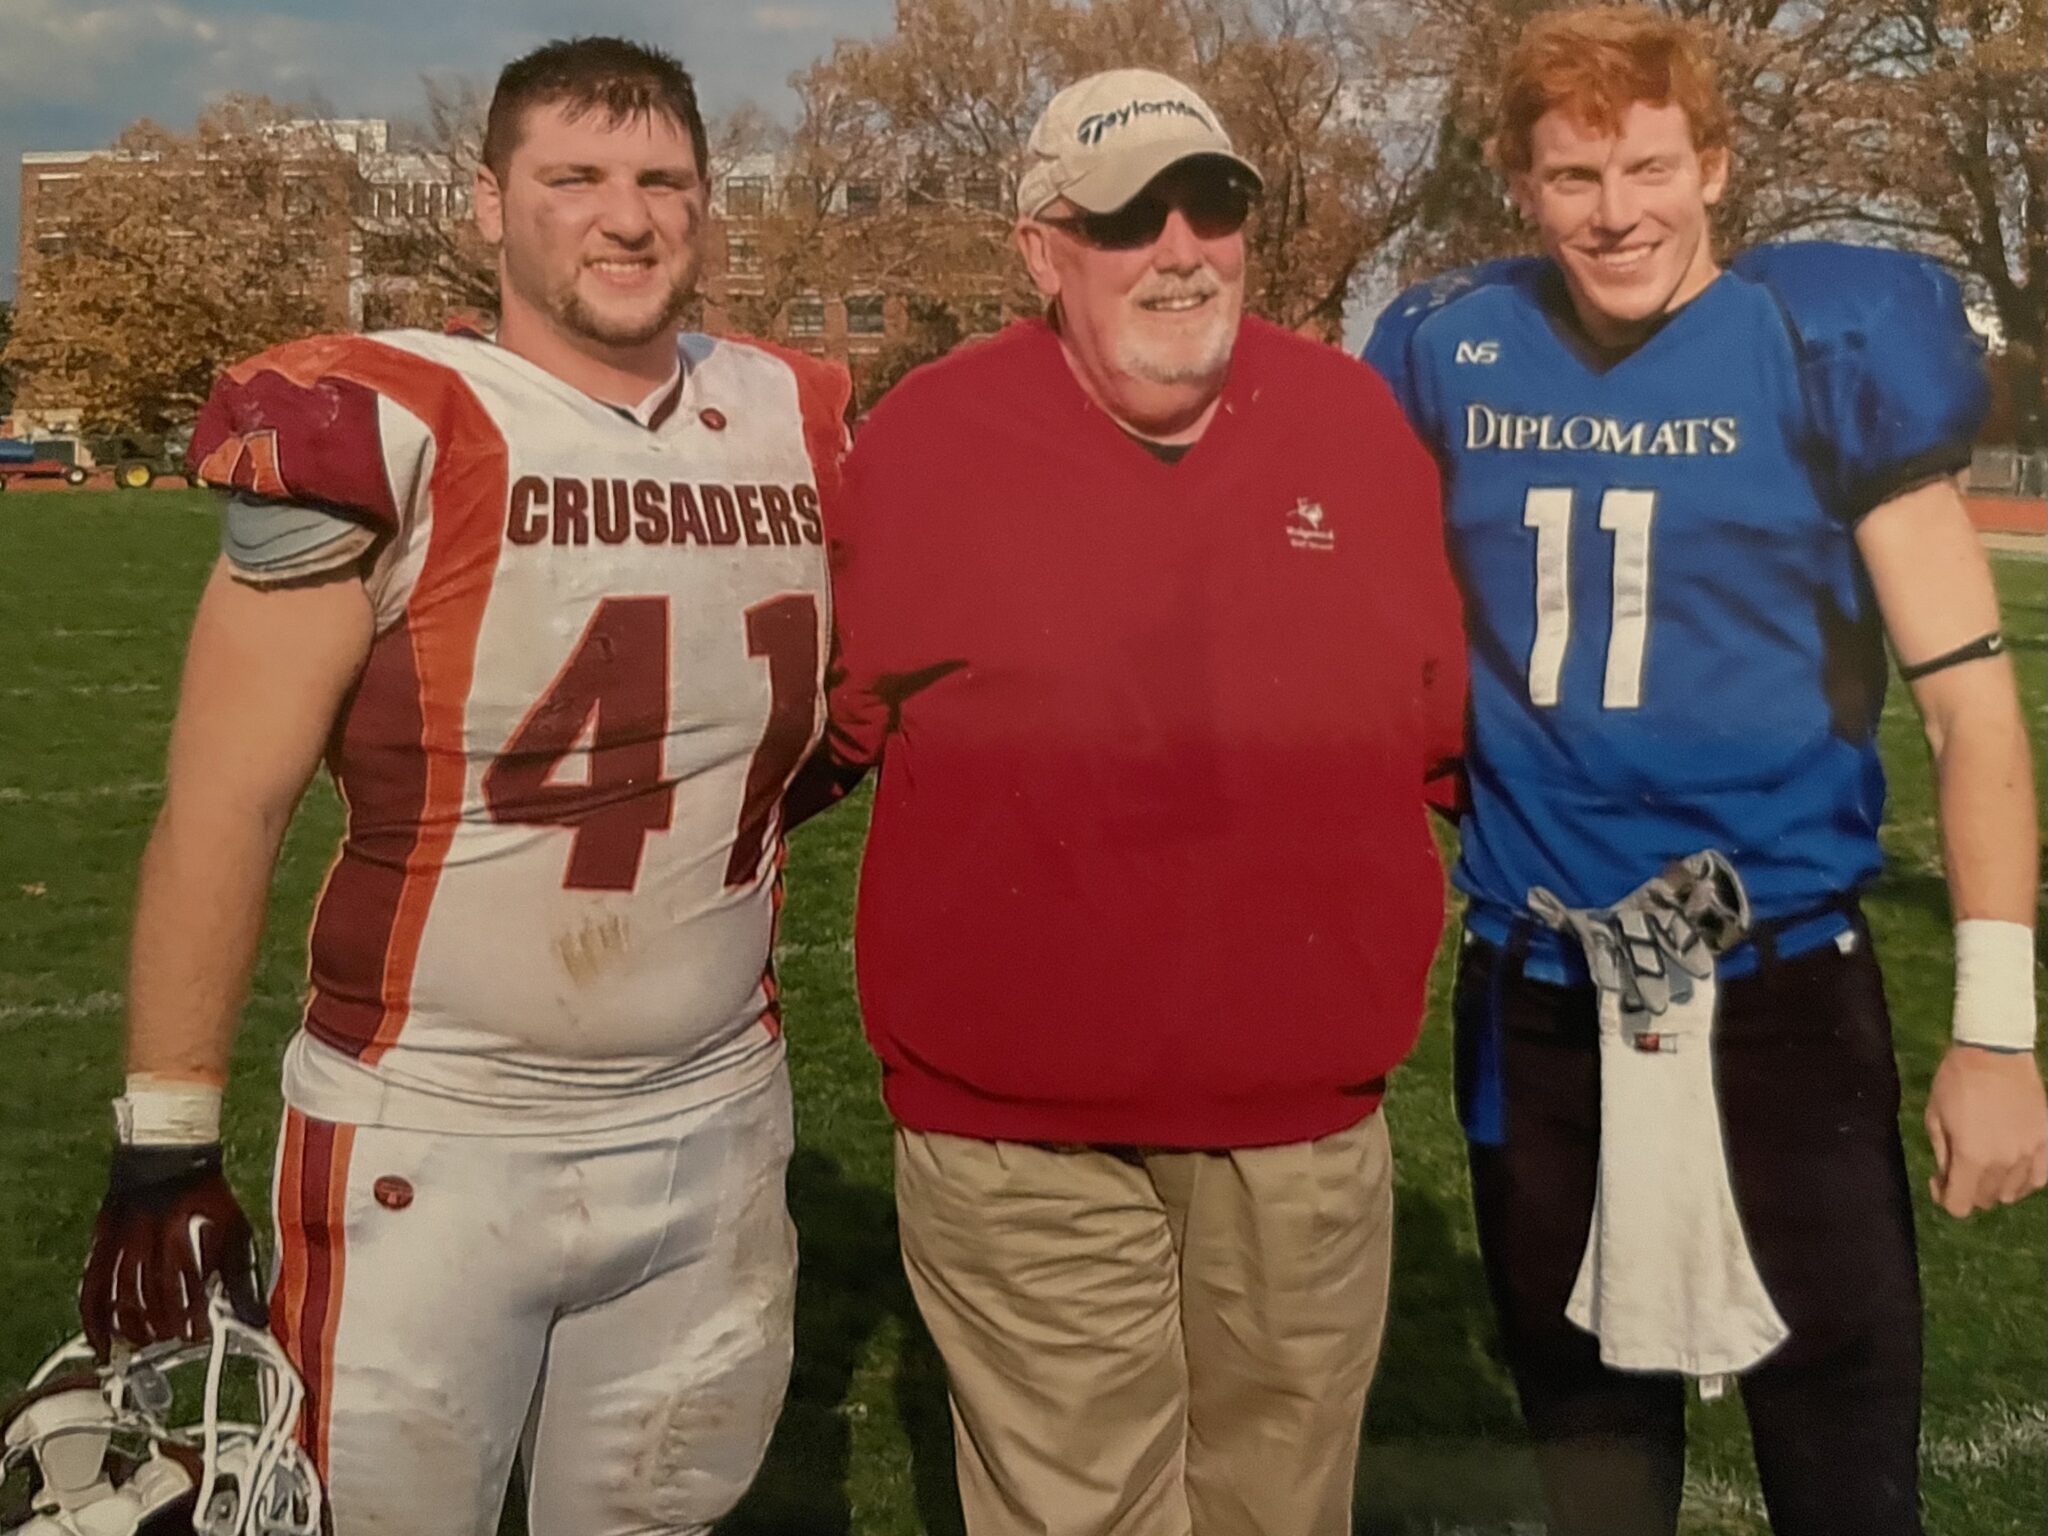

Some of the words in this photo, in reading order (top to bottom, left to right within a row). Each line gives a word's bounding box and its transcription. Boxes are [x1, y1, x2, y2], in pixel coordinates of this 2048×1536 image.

[506, 475, 824, 546] CRUSADERS
[1523, 487, 1656, 708] 11
[481, 595, 822, 891] 41
